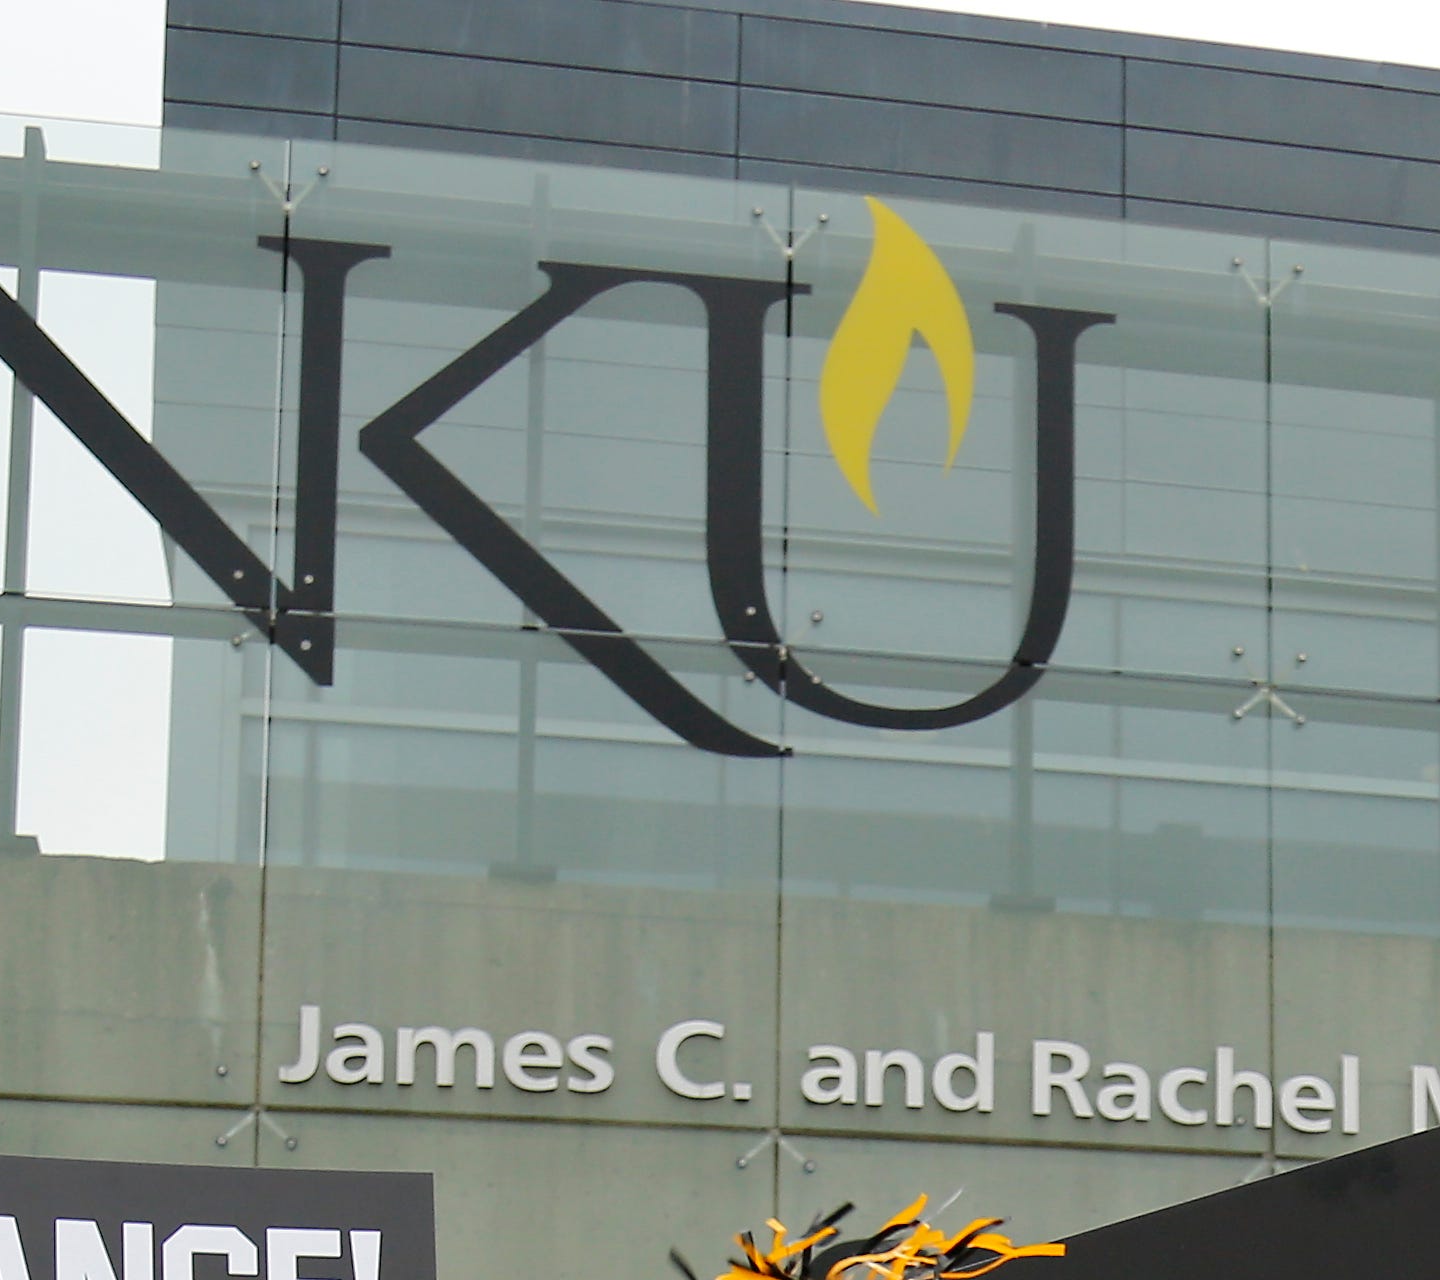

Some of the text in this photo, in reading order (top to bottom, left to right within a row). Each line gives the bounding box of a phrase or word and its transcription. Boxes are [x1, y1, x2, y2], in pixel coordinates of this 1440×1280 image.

[277, 1004, 615, 1097] James
[655, 1019, 751, 1103] C.
[799, 1032, 994, 1115] and
[1030, 1039, 1360, 1137] Rachel
